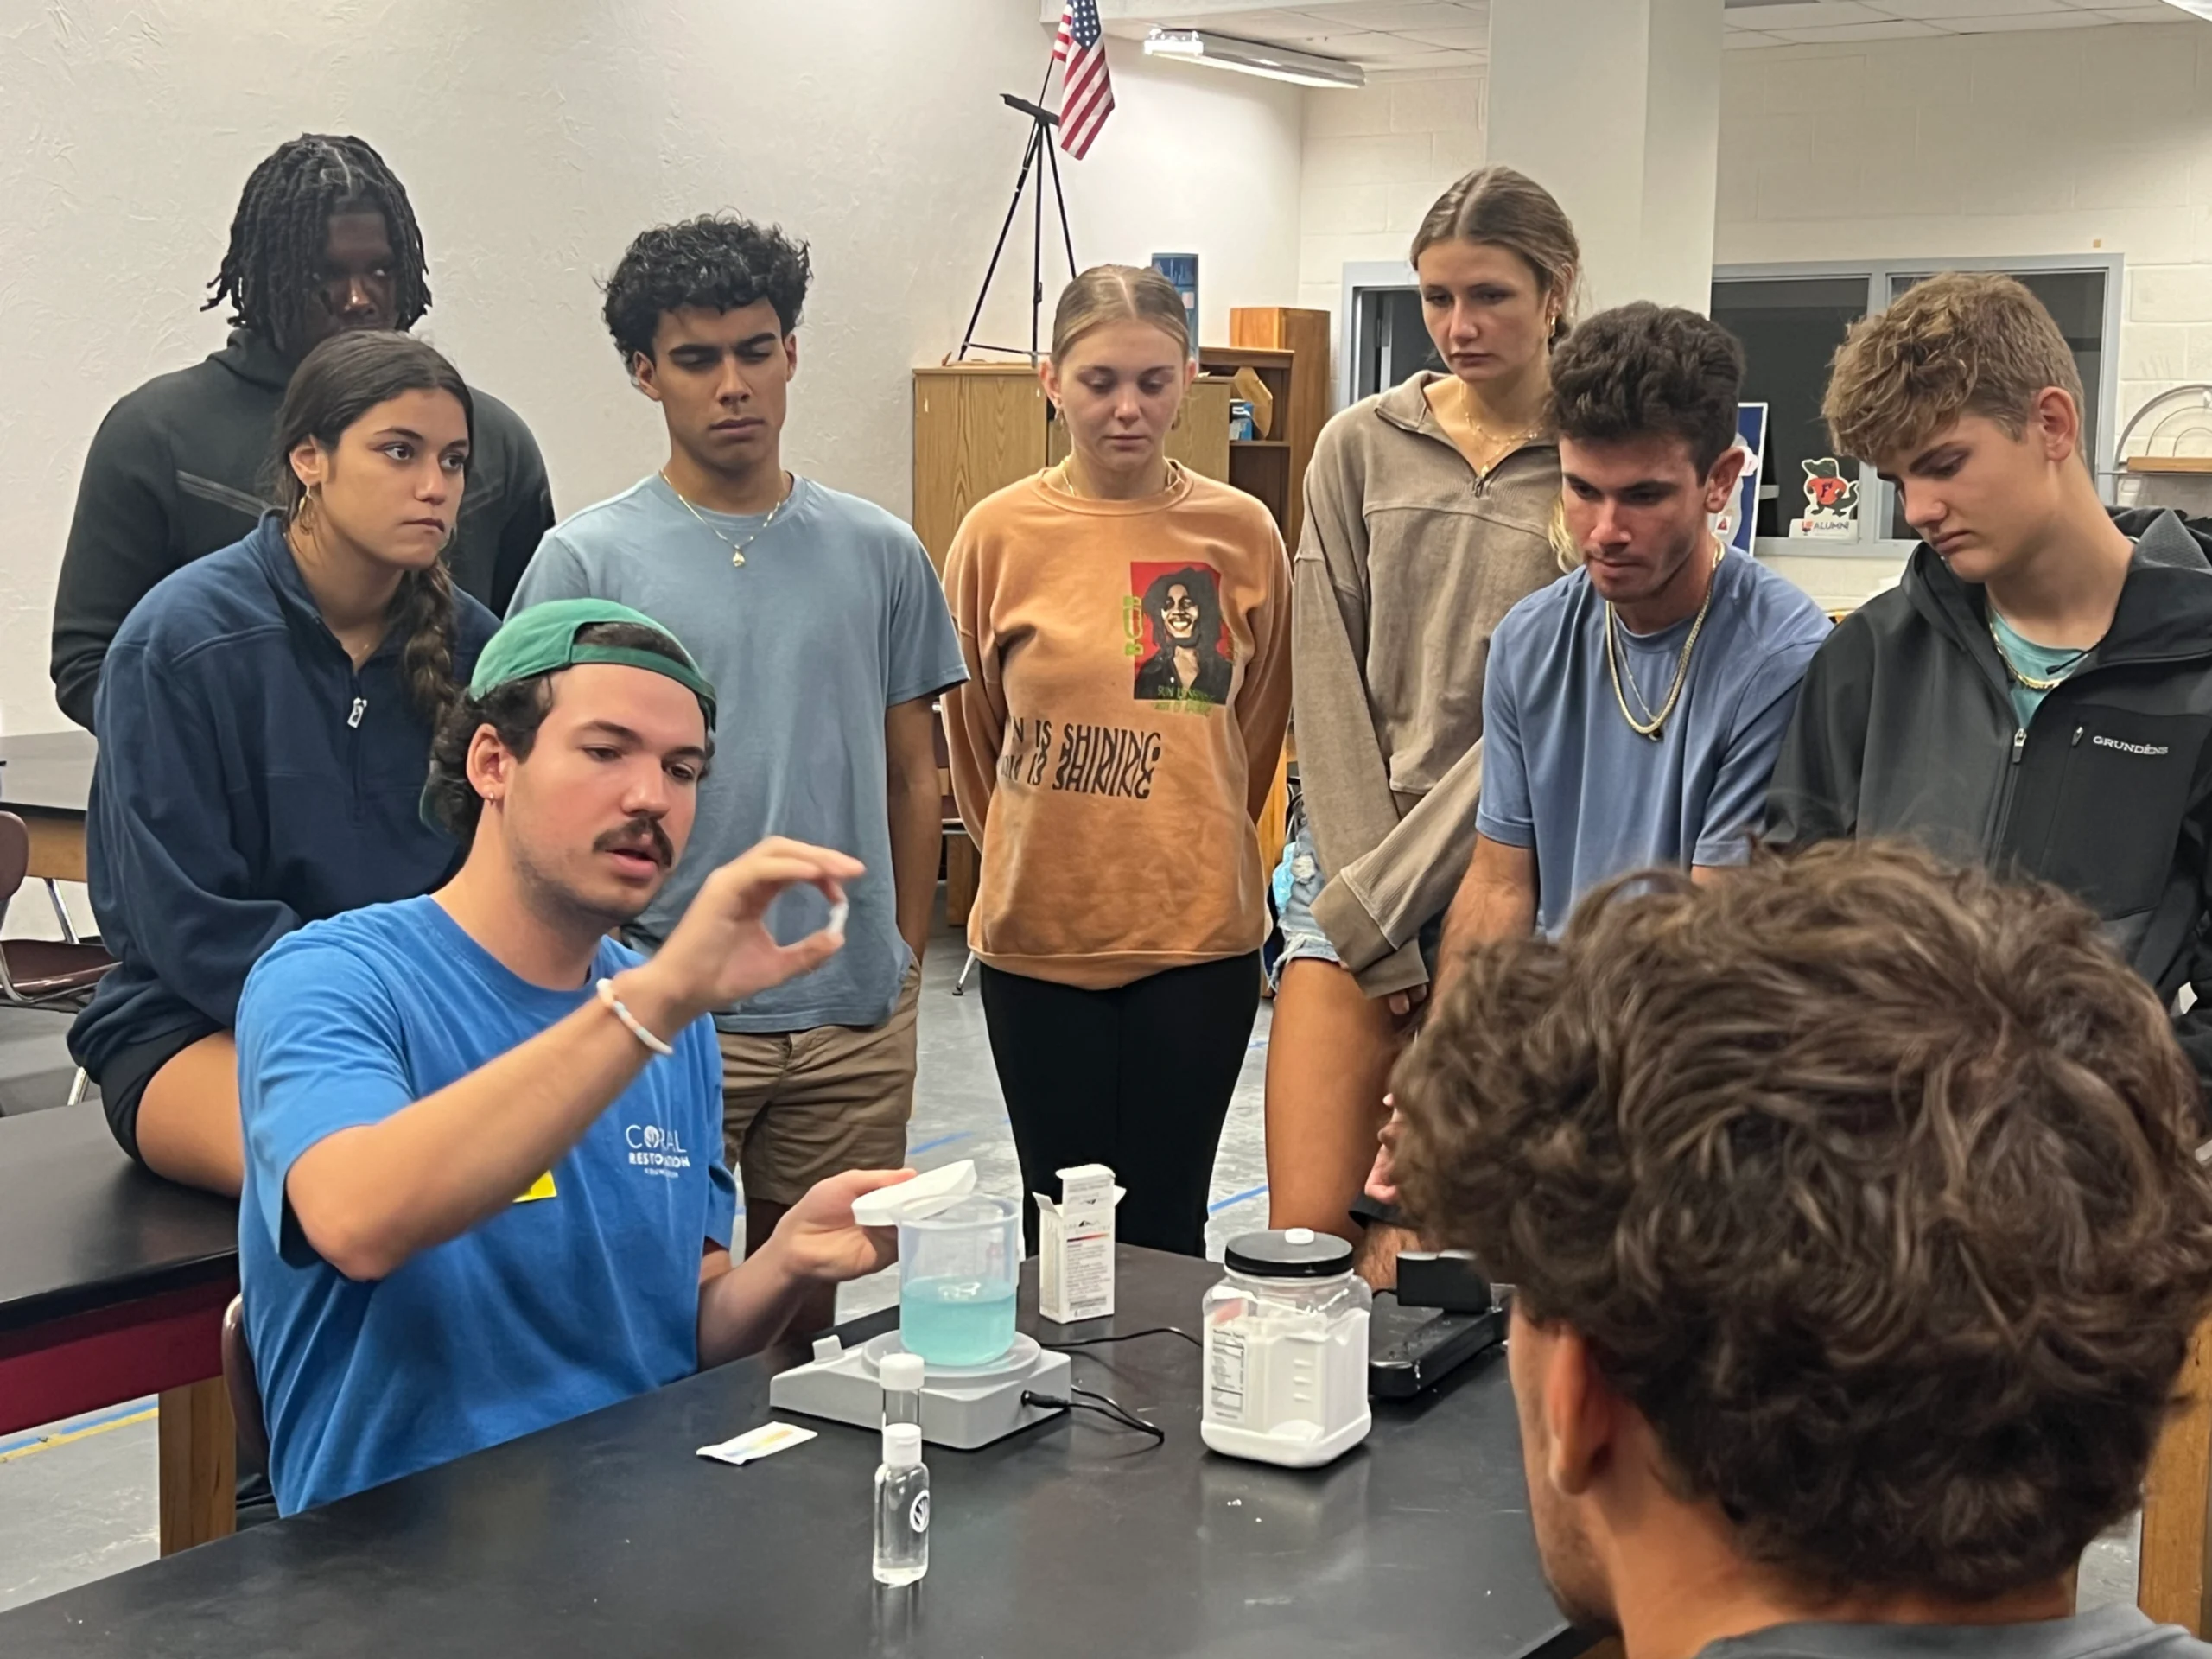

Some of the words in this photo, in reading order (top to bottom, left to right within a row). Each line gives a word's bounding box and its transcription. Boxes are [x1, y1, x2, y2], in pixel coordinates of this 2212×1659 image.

[1814, 521, 1850, 530] ALUMNI
[1035, 720, 1052, 752] IS
[1059, 722, 1161, 770] SHINING
[626, 1124, 687, 1153] CORAL
